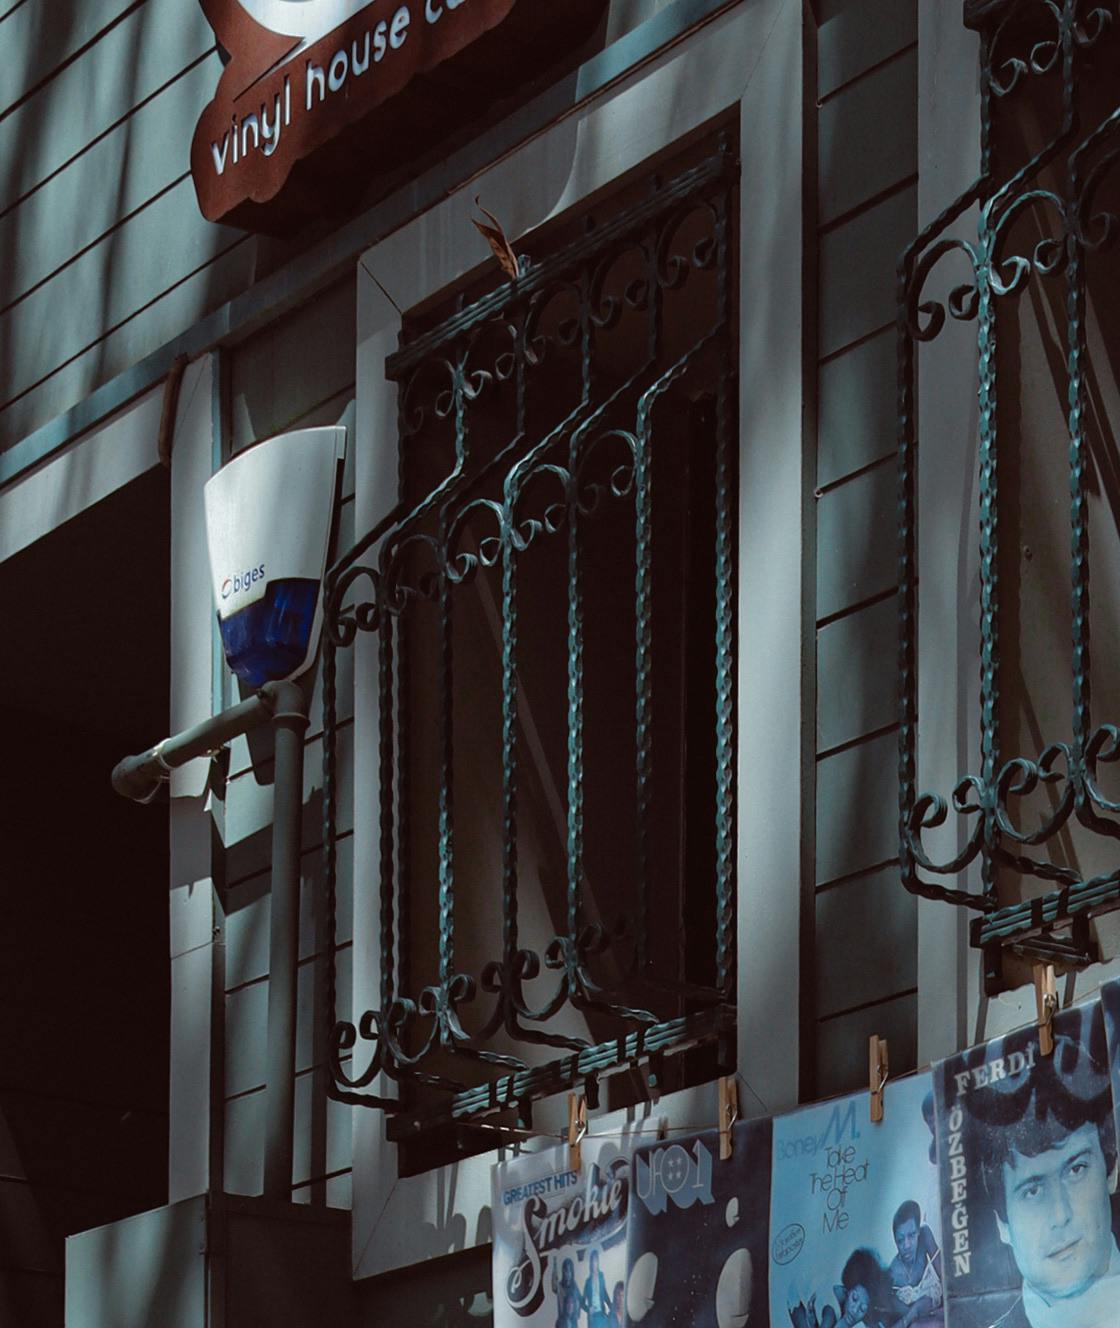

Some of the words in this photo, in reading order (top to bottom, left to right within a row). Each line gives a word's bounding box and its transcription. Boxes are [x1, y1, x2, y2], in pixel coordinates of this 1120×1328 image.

[211, 73, 291, 175] vinyl
[305, 5, 411, 111] house
[233, 563, 265, 594] biges
[824, 1145, 856, 1168] Take
[503, 1177, 553, 1206] GREATEST
[554, 1170, 578, 1188] HITS
[810, 1173, 832, 1195] The
[834, 1158, 870, 1188] Heat
[827, 1186, 848, 1211] Of
[506, 1158, 630, 1310] Smokie
[822, 1210, 849, 1234] Me
